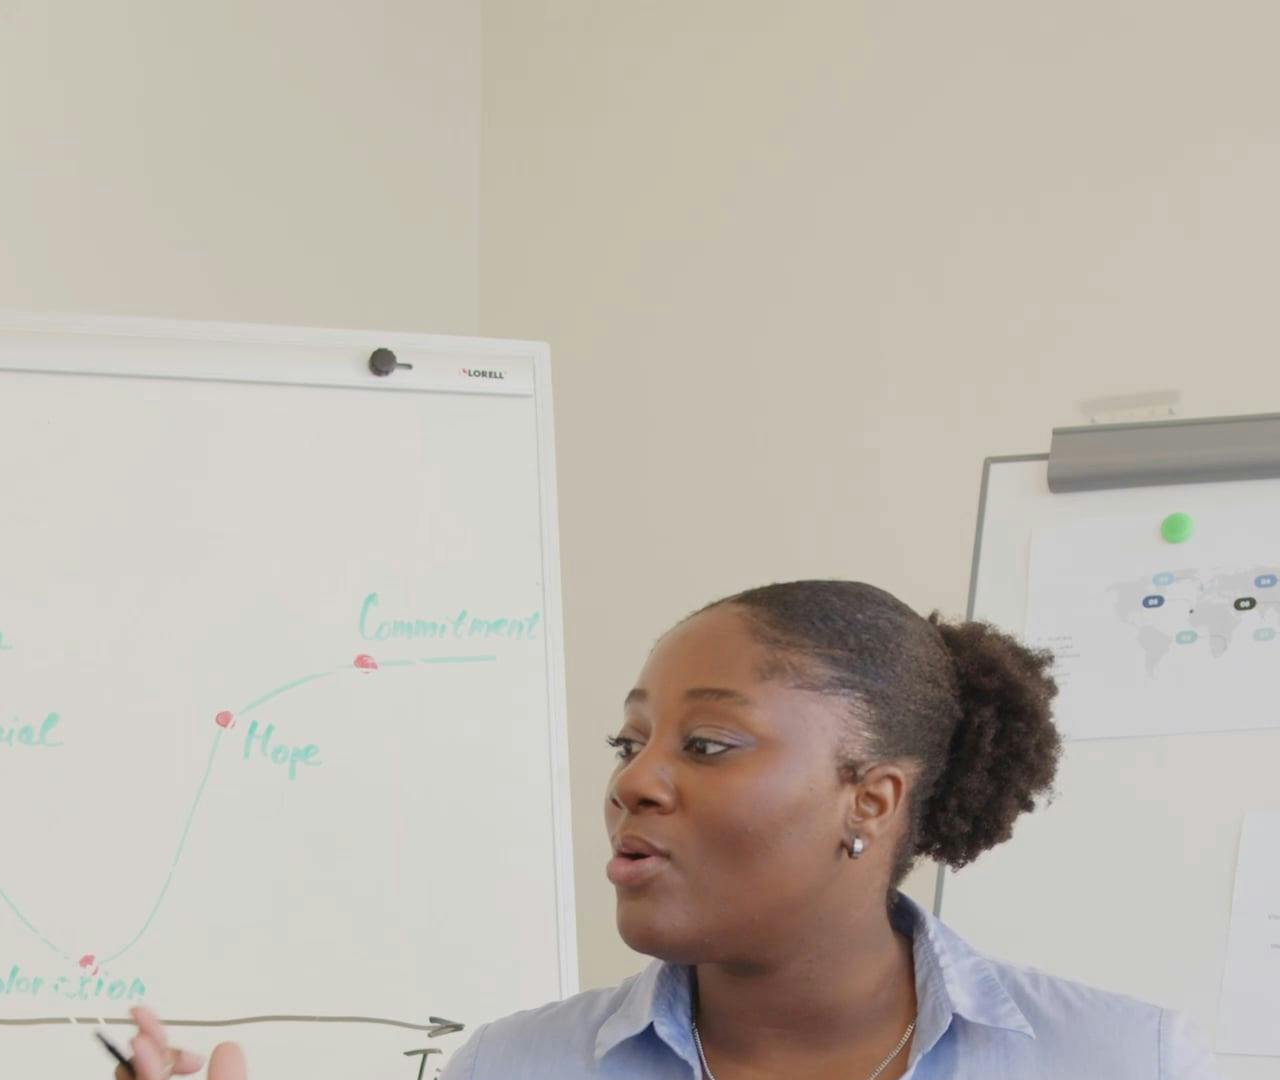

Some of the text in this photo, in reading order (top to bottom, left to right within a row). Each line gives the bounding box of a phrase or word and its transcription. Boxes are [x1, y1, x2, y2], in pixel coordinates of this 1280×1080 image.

[467, 369, 505, 380] LORELL
[358, 592, 540, 641] Commitment
[242, 719, 322, 781] Hope
